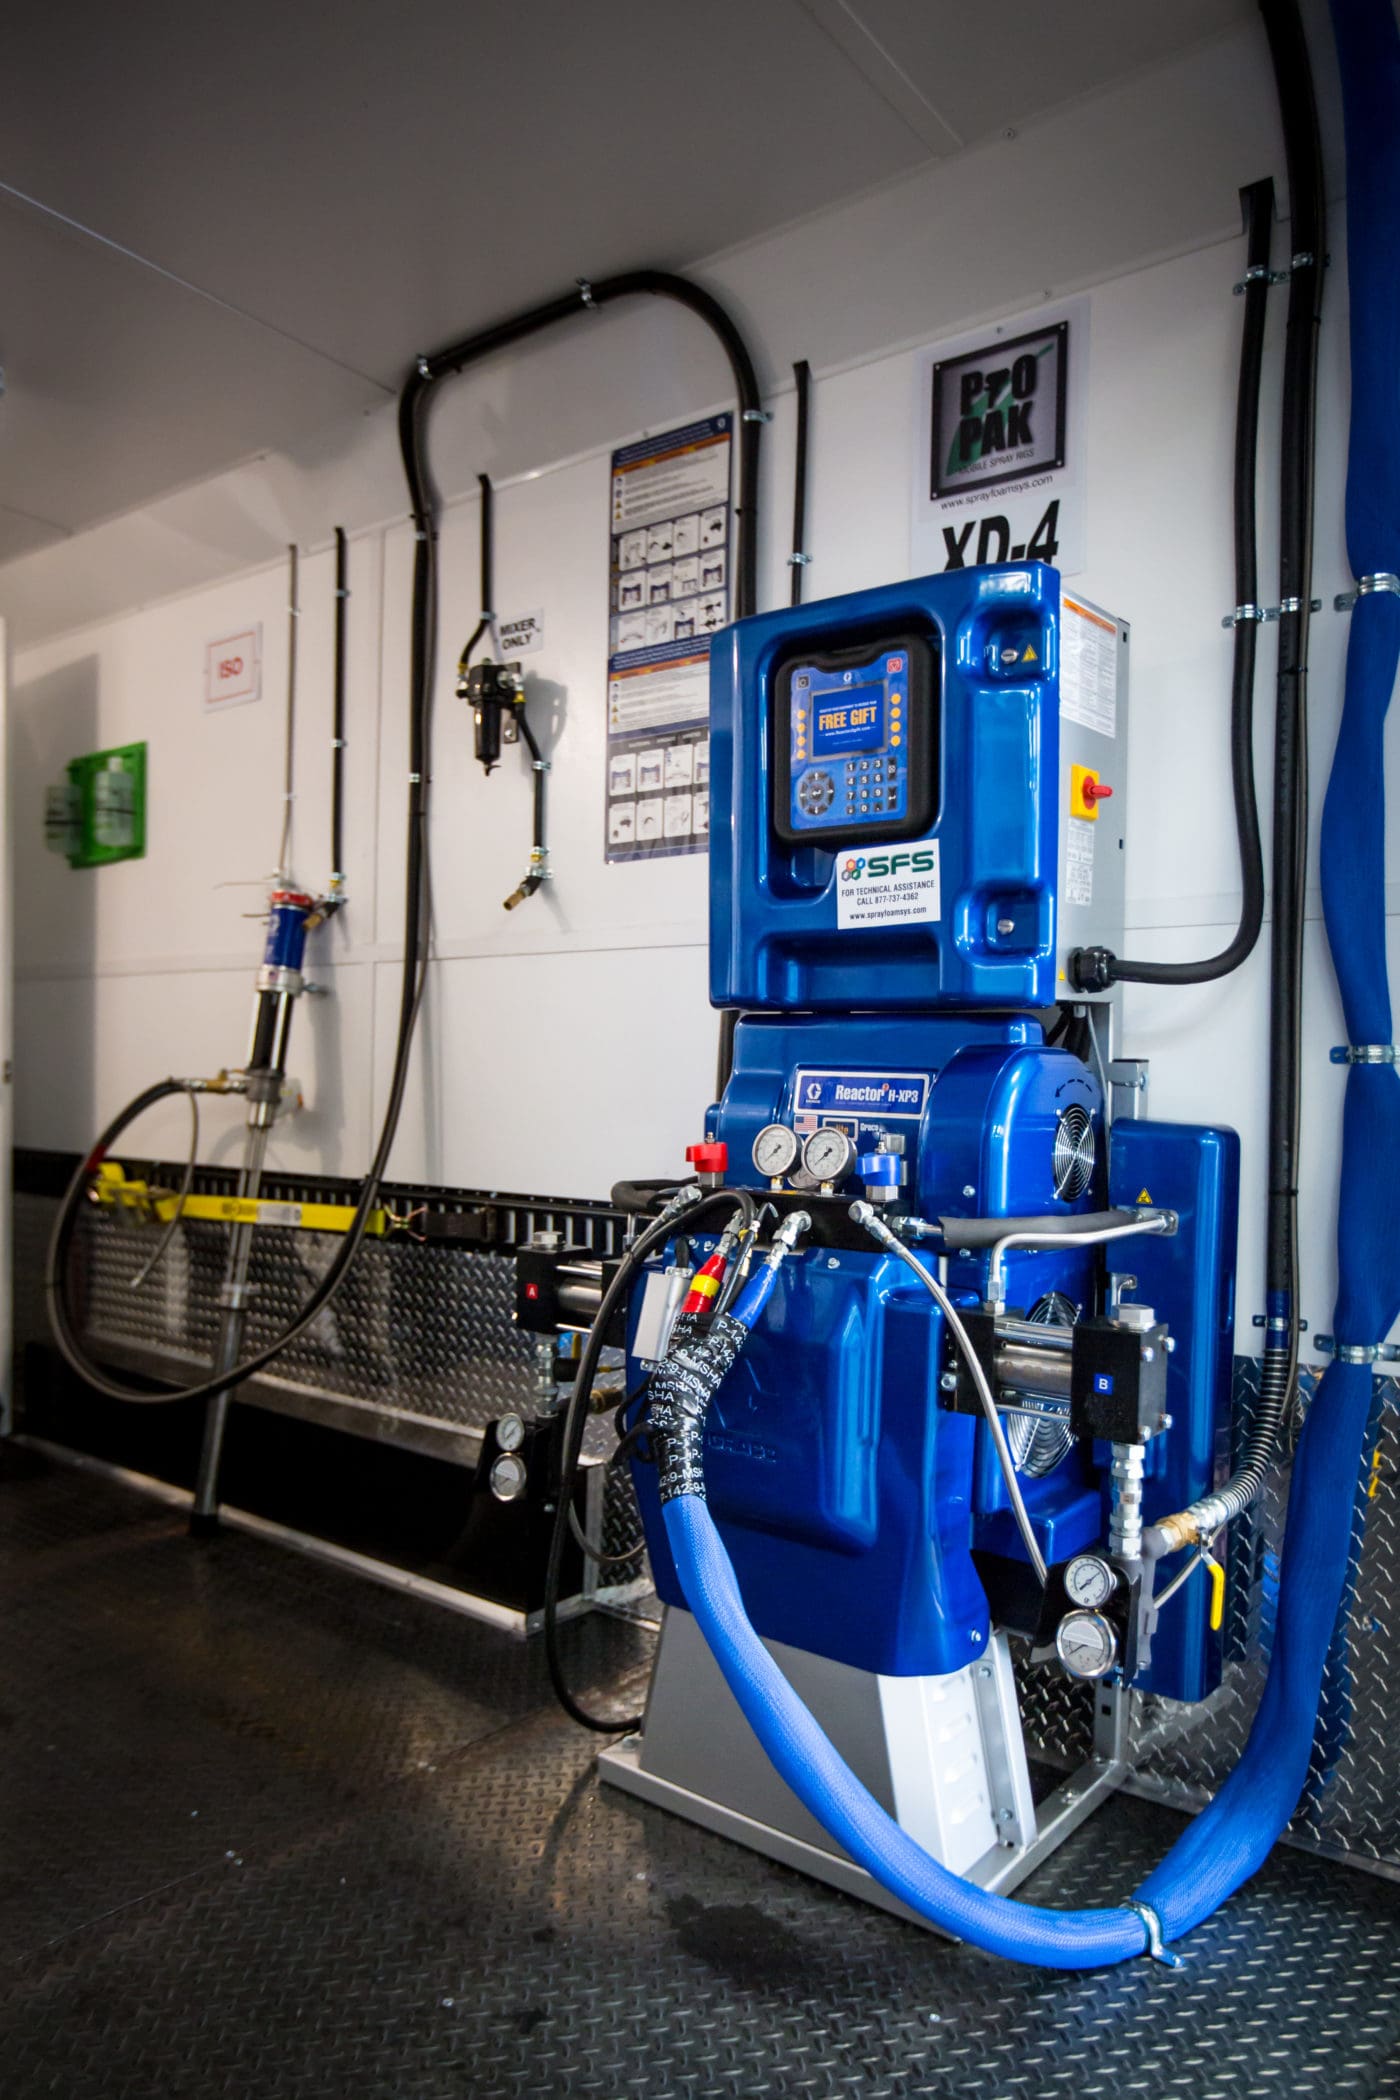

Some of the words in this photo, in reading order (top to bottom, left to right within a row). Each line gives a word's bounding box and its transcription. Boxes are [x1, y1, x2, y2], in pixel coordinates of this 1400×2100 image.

[958, 401, 1034, 462] PAK
[989, 455, 1015, 468] SPRAY
[940, 475, 1054, 510] www.sprayfoamsys.com
[942, 499, 1061, 573] XD-4
[500, 617, 535, 636] MIXER
[502, 632, 532, 650] ONLY
[218, 656, 244, 680] ISO
[819, 711, 847, 731] FREE
[850, 706, 877, 726] GIFT
[867, 850, 935, 878] SFS
[841, 888, 855, 897] FOR
[856, 885, 891, 896] TECHNICAL
[893, 879, 935, 892] ASSISTANCE
[856, 896, 874, 906] CALL
[874, 892, 919, 904] 877-737-4362
[849, 906, 927, 920] www.sprayfoamsys.com
[835, 1084, 885, 1102] Reactor
[888, 1089, 919, 1104] H-XP3
[529, 1287, 536, 1297] A
[1098, 1378, 1109, 1390] B
